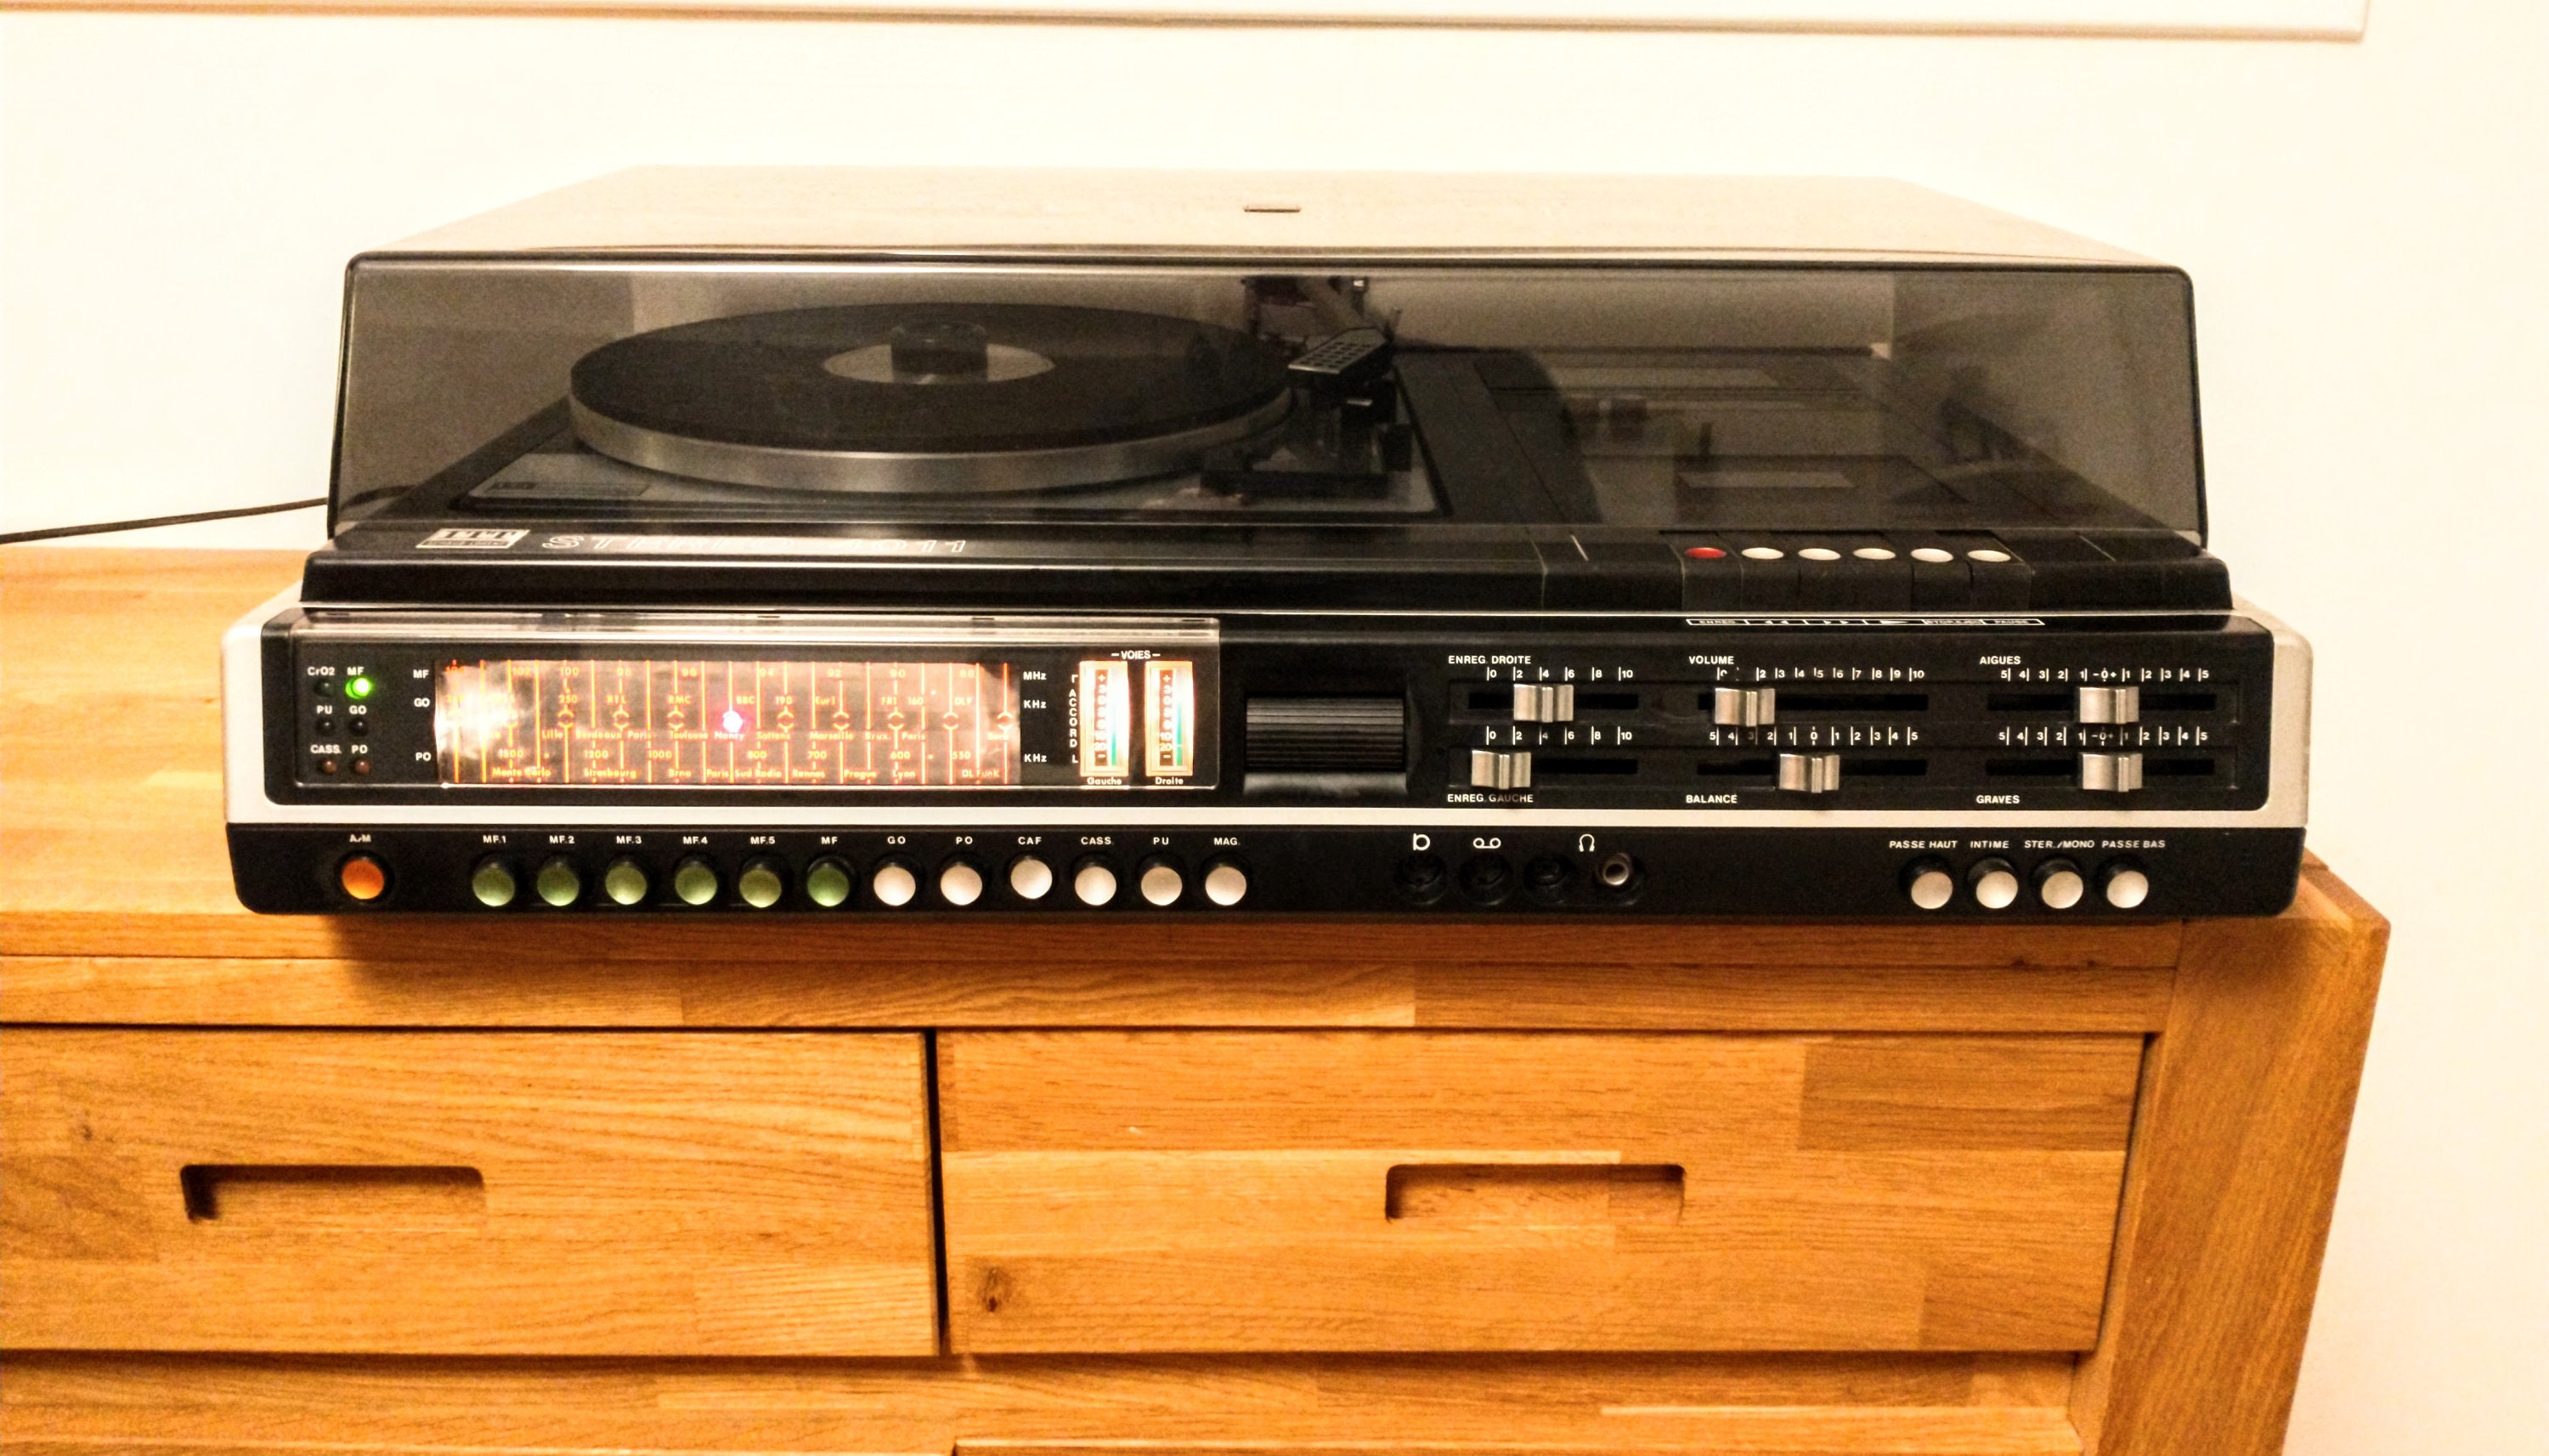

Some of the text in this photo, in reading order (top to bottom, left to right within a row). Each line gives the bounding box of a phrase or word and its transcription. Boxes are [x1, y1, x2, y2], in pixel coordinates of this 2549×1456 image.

[1121, 650, 1150, 659] VOIES
[1492, 655, 1531, 664] DROITE
[1689, 656, 1734, 664] VOLUME
[1980, 656, 2021, 665] AIGUES
[307, 667, 335, 676] CrO2
[347, 667, 365, 675] MF
[414, 669, 429, 679] MF
[561, 667, 579, 676] 100
[890, 669, 905, 678] 90
[1489, 669, 1633, 679] 0 2 4 6 8 10
[2000, 670, 2008, 679] 5
[2019, 670, 2026, 679] 4
[2039, 670, 2046, 679] 3
[2058, 670, 2065, 679] 2
[2145, 670, 2152, 679] 2
[2164, 670, 2172, 679] 3
[2183, 670, 2190, 679] 4
[2201, 670, 2209, 679] 5
[1023, 672, 1047, 680] MHz
[414, 698, 430, 707] GO
[317, 706, 332, 714] PU
[349, 706, 367, 714] GO
[1069, 689, 1078, 748] ACCORD
[542, 730, 563, 739] Lille
[628, 731, 651, 739] Paris
[715, 731, 744, 741] Nancy
[1489, 731, 1632, 740] 0 2 4 6 8 10
[1710, 732, 1716, 741] 5
[1728, 732, 1735, 741] 4
[1767, 732, 1774, 741] 2
[1854, 732, 1861, 741] 2
[1874, 732, 1881, 741] 3
[1891, 732, 1899, 741] 4
[1911, 732, 1919, 741] 5
[1998, 732, 2005, 741] 5
[2017, 732, 2024, 741] 4
[2037, 732, 2043, 741] 3
[2056, 732, 2063, 741] 2
[2143, 732, 2150, 741] 2
[2162, 732, 2170, 741] 3
[2181, 732, 2189, 741] 4
[2201, 732, 2207, 741] 5
[352, 745, 368, 753] PO
[415, 752, 432, 761] PO
[1025, 754, 1047, 763] KHz
[584, 768, 637, 780] Strasbourg
[707, 769, 729, 777] Paris
[735, 769, 751, 777] Sud
[755, 769, 782, 777] Radio
[844, 770, 877, 779] Prague
[892, 770, 916, 779] Lyon
[1087, 776, 1122, 786] Gauche
[1156, 777, 1184, 786] Droite
[1489, 793, 1534, 803] GAUCHE
[1686, 794, 1738, 804] BALANCE
[1976, 794, 2021, 804] GRAVES
[616, 835, 641, 844] MF.3
[750, 836, 775, 844] MF.5
[821, 836, 838, 844] MF
[887, 836, 907, 845] GO
[956, 836, 973, 845] PO
[1018, 836, 1042, 845] CAF
[1153, 837, 1169, 846] PU
[1889, 840, 1958, 849] PASSE HAUT
[1970, 840, 2009, 849] INTIME
[2101, 840, 2166, 849] PASSE BAS
